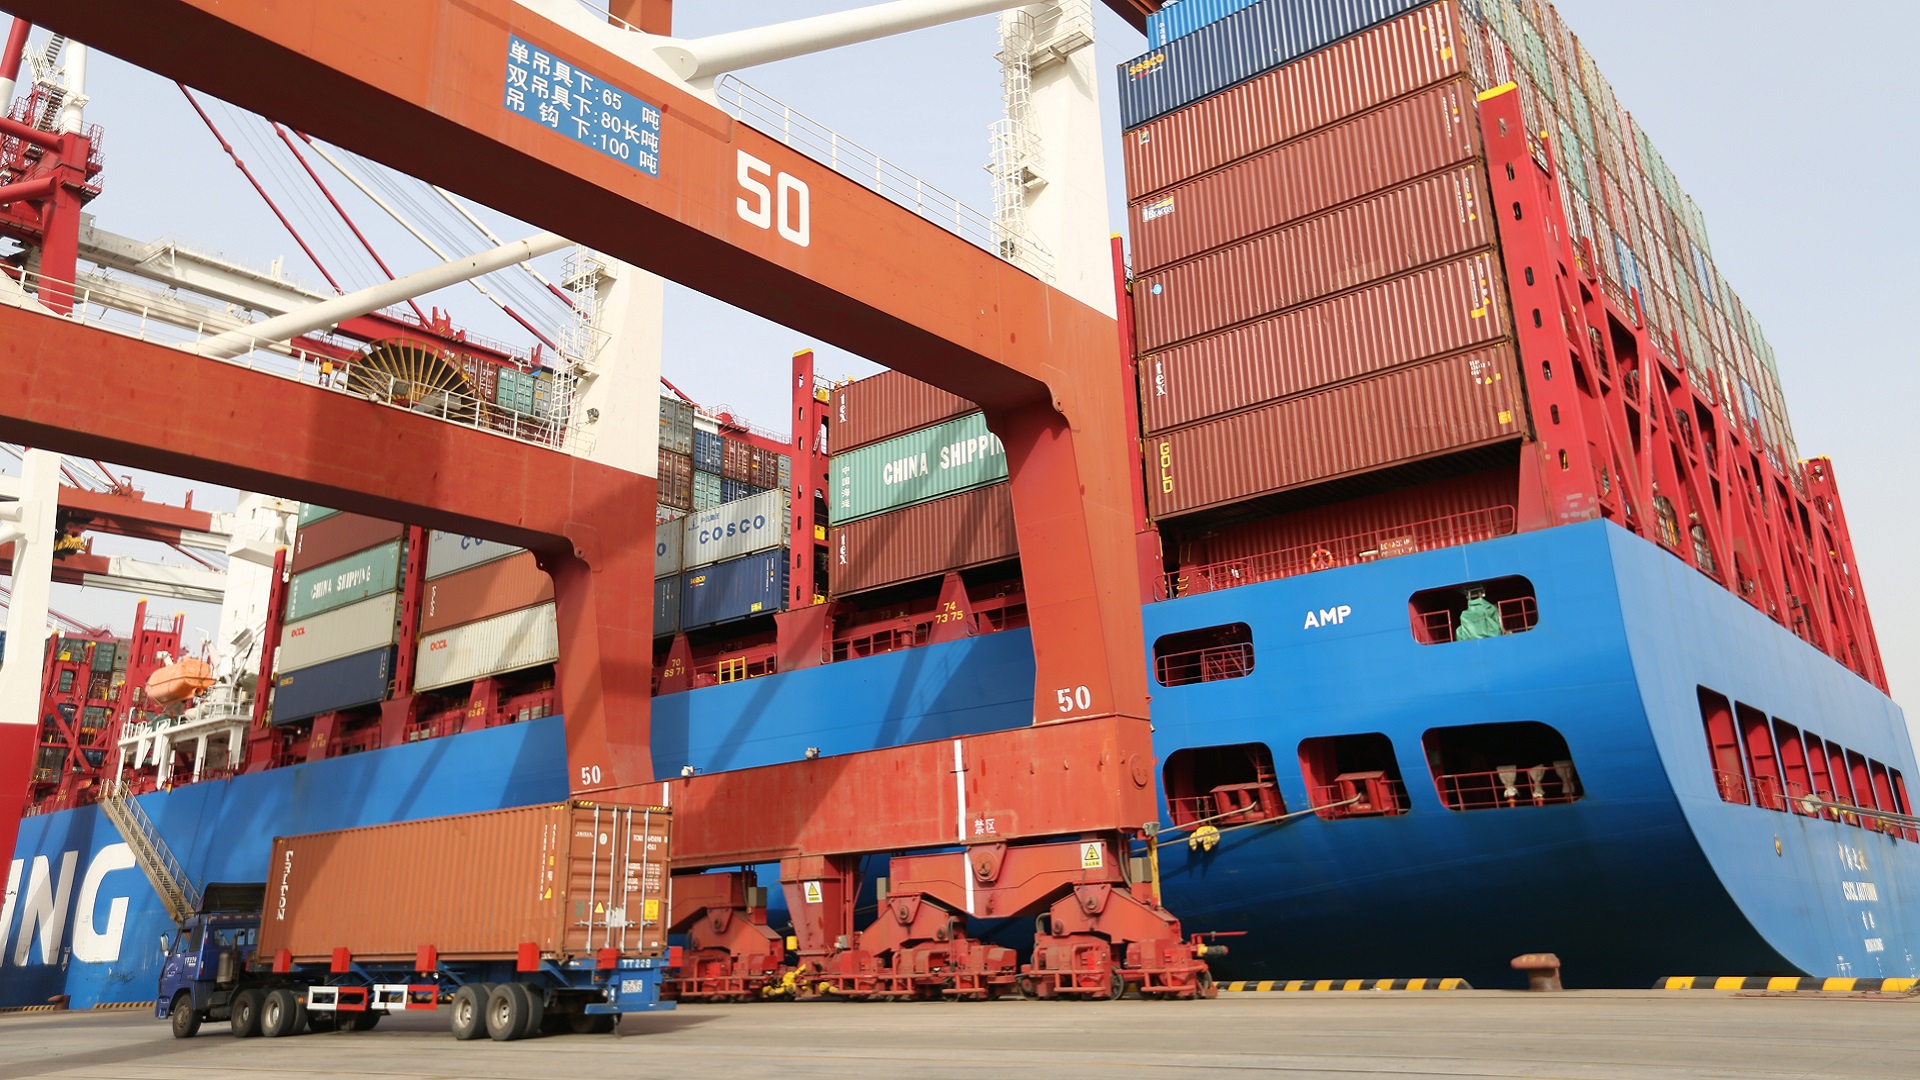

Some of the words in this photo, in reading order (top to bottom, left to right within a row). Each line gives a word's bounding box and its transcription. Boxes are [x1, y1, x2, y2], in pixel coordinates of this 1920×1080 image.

[736, 149, 810, 248] 50
[1155, 359, 1167, 397] tex
[839, 393, 847, 424] tex
[883, 452, 929, 486] CHINA
[1160, 442, 1173, 494] GOLD
[699, 514, 766, 545] COSCO
[839, 533, 848, 565] tex
[310, 578, 333, 600] CHINA
[336, 565, 371, 592] SHIPPING
[935, 613, 948, 624] 73
[950, 610, 964, 621] 75
[943, 601, 957, 612] 74
[1303, 604, 1352, 630] AMP
[671, 658, 681, 667] 70
[676, 666, 685, 676] 71
[1057, 685, 1091, 713] 50
[581, 765, 601, 786] 50
[974, 818, 997, 836] 禁区
[0, 842, 137, 967] ING
